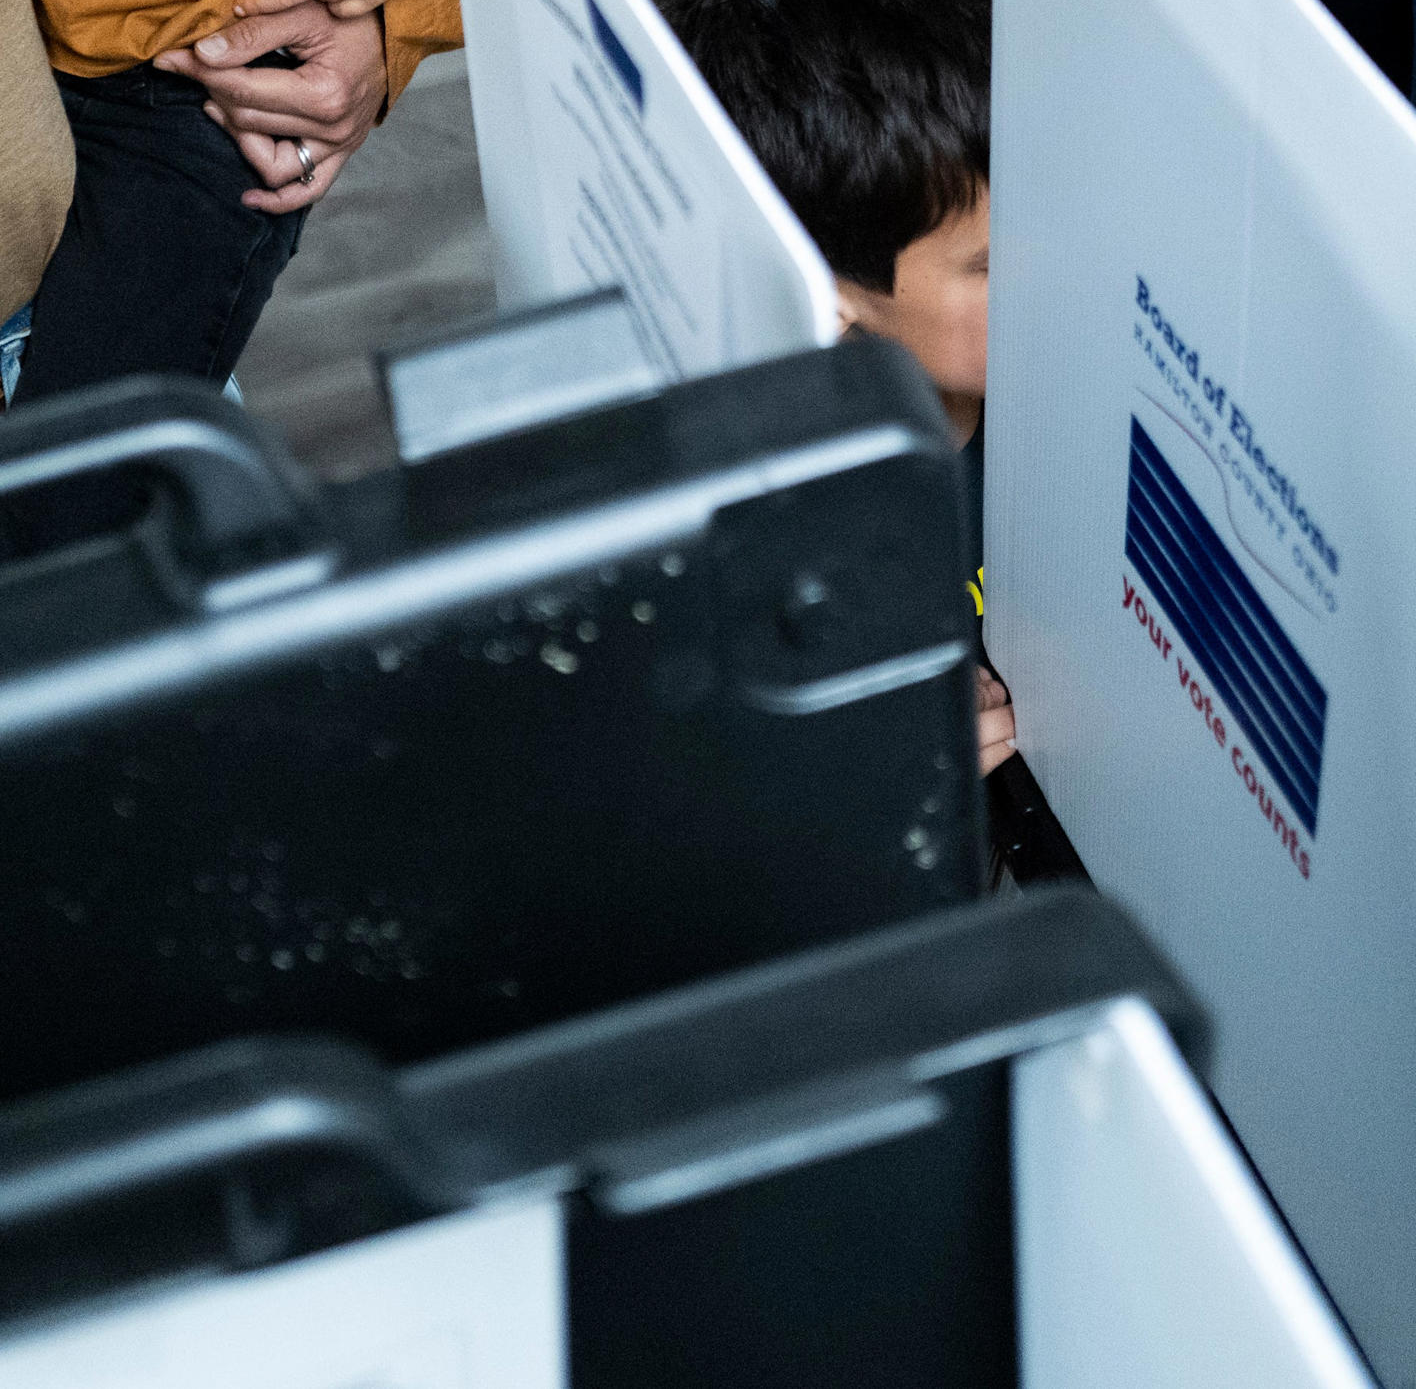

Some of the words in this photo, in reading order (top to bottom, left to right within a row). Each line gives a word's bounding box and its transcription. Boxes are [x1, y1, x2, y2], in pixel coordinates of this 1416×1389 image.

[1136, 274, 1199, 383] Board
[1203, 376, 1226, 418] of
[1231, 401, 1339, 576] Elections
[1122, 574, 1172, 662] your
[1177, 657, 1227, 748] vote
[1232, 746, 1311, 881] counts
